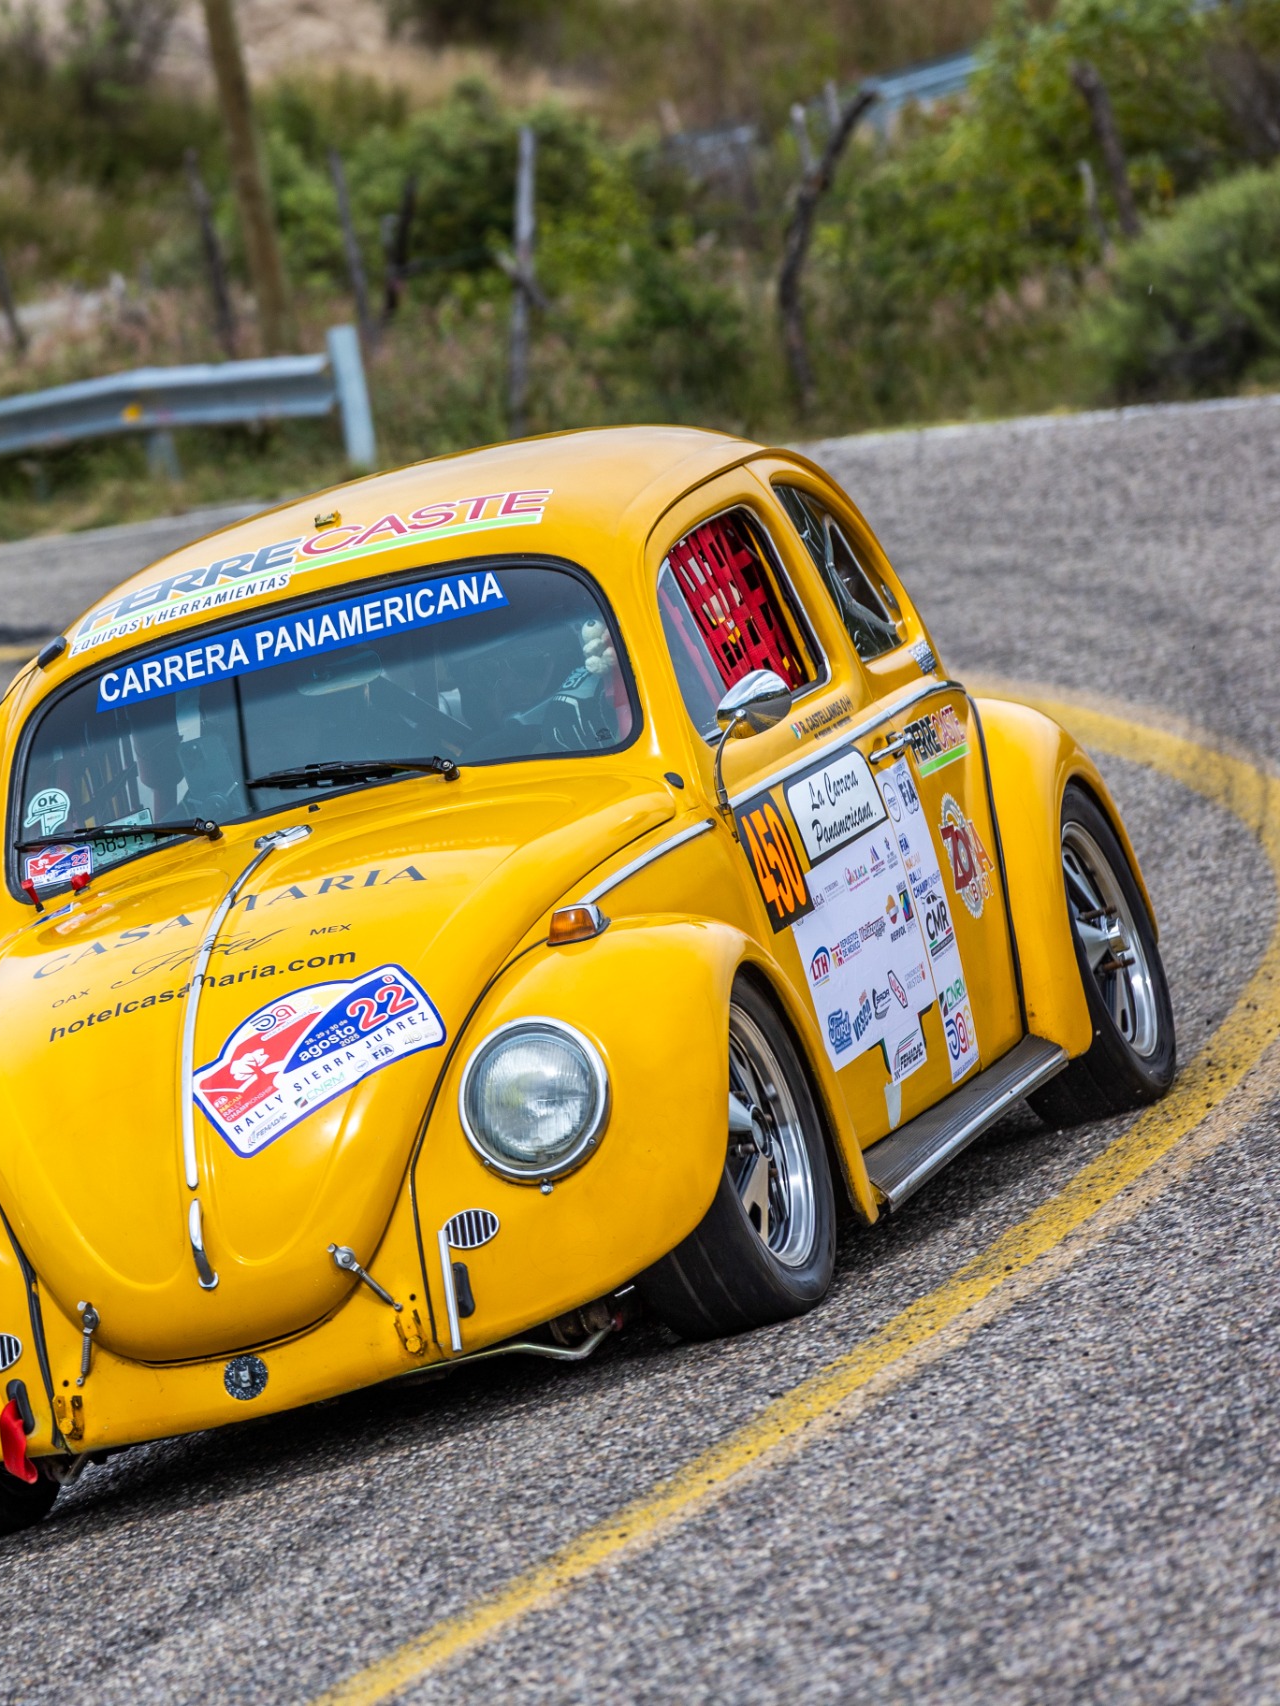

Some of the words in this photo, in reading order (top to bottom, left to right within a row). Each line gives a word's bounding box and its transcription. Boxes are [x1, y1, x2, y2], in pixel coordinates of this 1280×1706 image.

[76, 489, 553, 638] FERRECASTE
[71, 619, 142, 656] EQUIPOS
[142, 613, 154, 629] Y
[154, 573, 290, 624] HERRAMIENTAS
[99, 639, 249, 703] CARRERA
[255, 572, 504, 662] PANAMERICANA
[805, 701, 843, 731] CASTELLANOS
[37, 794, 59, 808] OK
[808, 781, 825, 811] La
[824, 770, 859, 807] Carrera
[71, 853, 89, 867] 22
[740, 802, 807, 919] 450
[909, 867, 922, 885] RALLY
[309, 923, 352, 936] MEX
[925, 900, 950, 941] CMR
[33, 913, 194, 979] CASA
[839, 931, 859, 948] REPUESTOS
[811, 954, 829, 981] LTH
[52, 989, 91, 1009] OAX
[347, 985, 417, 1031] 22
[339, 1019, 348, 1027] de
[828, 1008, 851, 1046] Ford
[852, 998, 873, 1042] VESCO
[299, 1026, 356, 1061] agosto
[234, 1094, 283, 1135] RALLY
[293, 1051, 355, 1092] SIERRA
[366, 1012, 429, 1049] JUÁREZ
[219, 1094, 243, 1113] NACAM
[223, 1101, 242, 1118] RALLY
[226, 1086, 273, 1122] CHAMPIONSHIP
